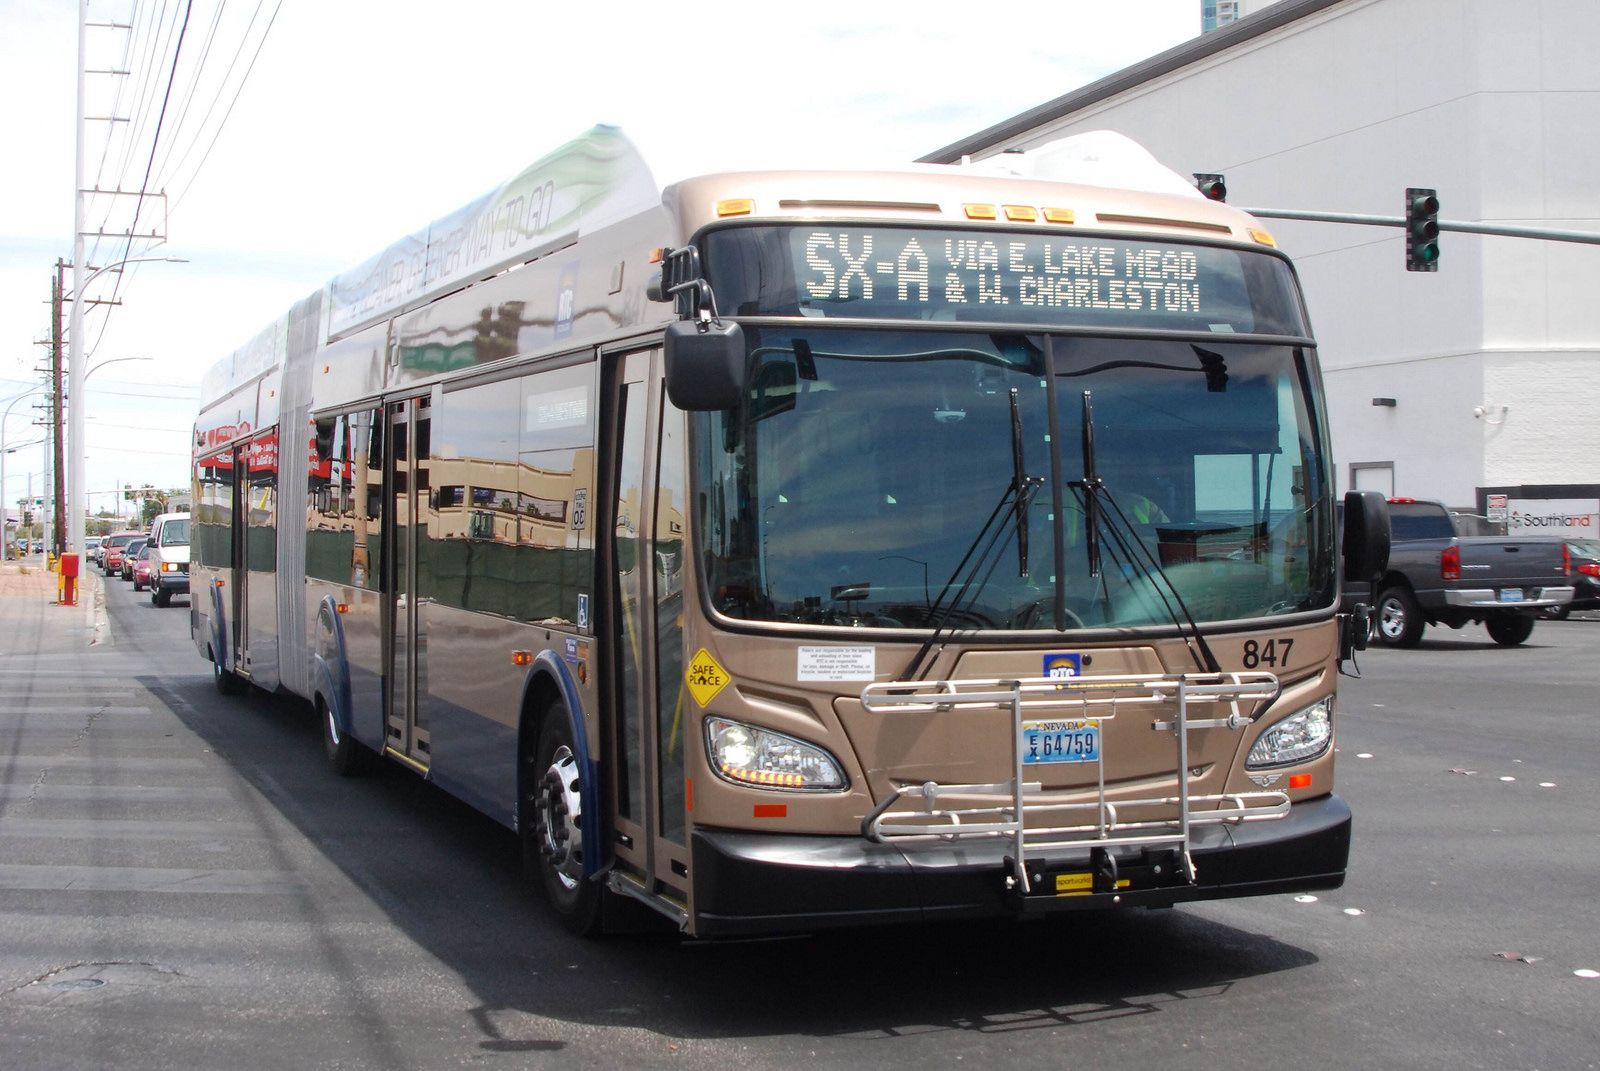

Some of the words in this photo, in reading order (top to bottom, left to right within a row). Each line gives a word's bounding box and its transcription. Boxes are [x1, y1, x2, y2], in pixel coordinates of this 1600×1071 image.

[465, 207, 501, 267] WAY
[502, 195, 525, 250] TO
[525, 179, 555, 240] GO
[806, 232, 929, 302] SX-A
[944, 238, 999, 271] VIA
[1008, 242, 1035, 274] E.
[1044, 243, 1116, 277] LAKE
[1125, 248, 1199, 281] MEAD
[944, 272, 968, 304] &
[1018, 275, 1201, 313] CHARLESTON
[1524, 512, 1591, 527] Southland
[1242, 638, 1295, 669] 847
[692, 664, 714, 675] SAFE
[1043, 721, 1080, 731] NEVADA
[1043, 732, 1094, 756] 64759
